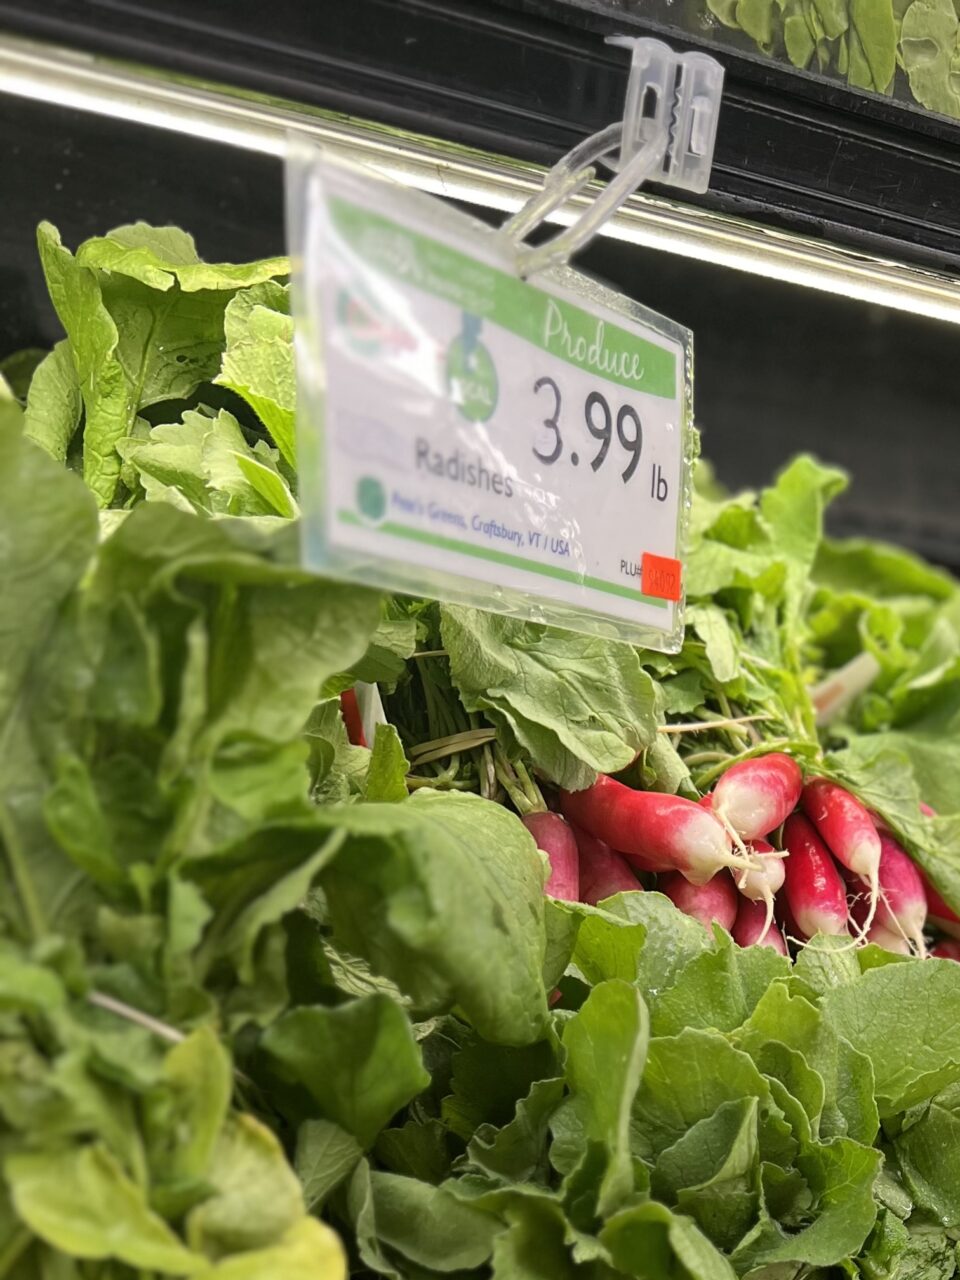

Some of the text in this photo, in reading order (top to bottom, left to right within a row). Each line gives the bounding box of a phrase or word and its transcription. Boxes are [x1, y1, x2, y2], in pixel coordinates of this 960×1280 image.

[544, 299, 644, 380] Produce
[415, 437, 513, 498] Radishes
[533, 376, 669, 502] 3.99 lb
[471, 513, 525, 548] Craftsbury,
[528, 529, 542, 549] VT
[550, 537, 571, 557] USA
